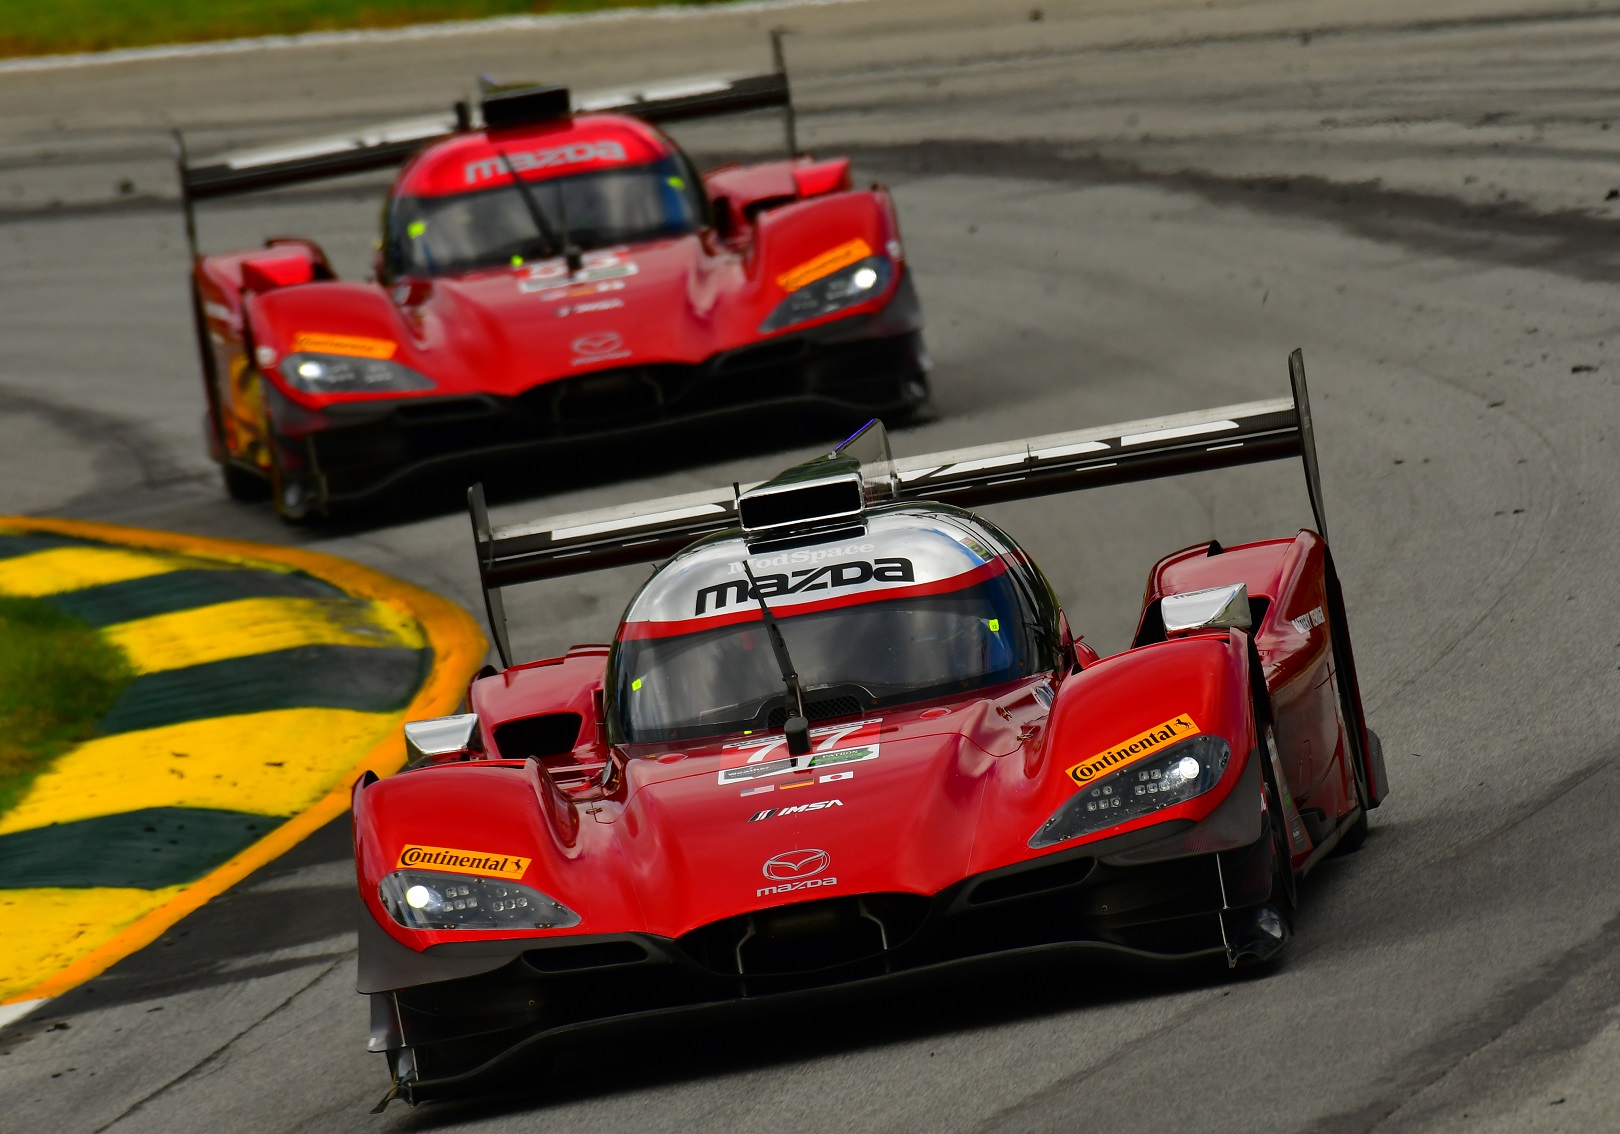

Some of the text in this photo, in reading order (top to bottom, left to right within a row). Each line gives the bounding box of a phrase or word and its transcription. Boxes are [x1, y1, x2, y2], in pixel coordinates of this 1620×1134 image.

[1071, 725, 1179, 783] Continental
[778, 799, 844, 817] IMSA
[401, 848, 509, 872] Continental
